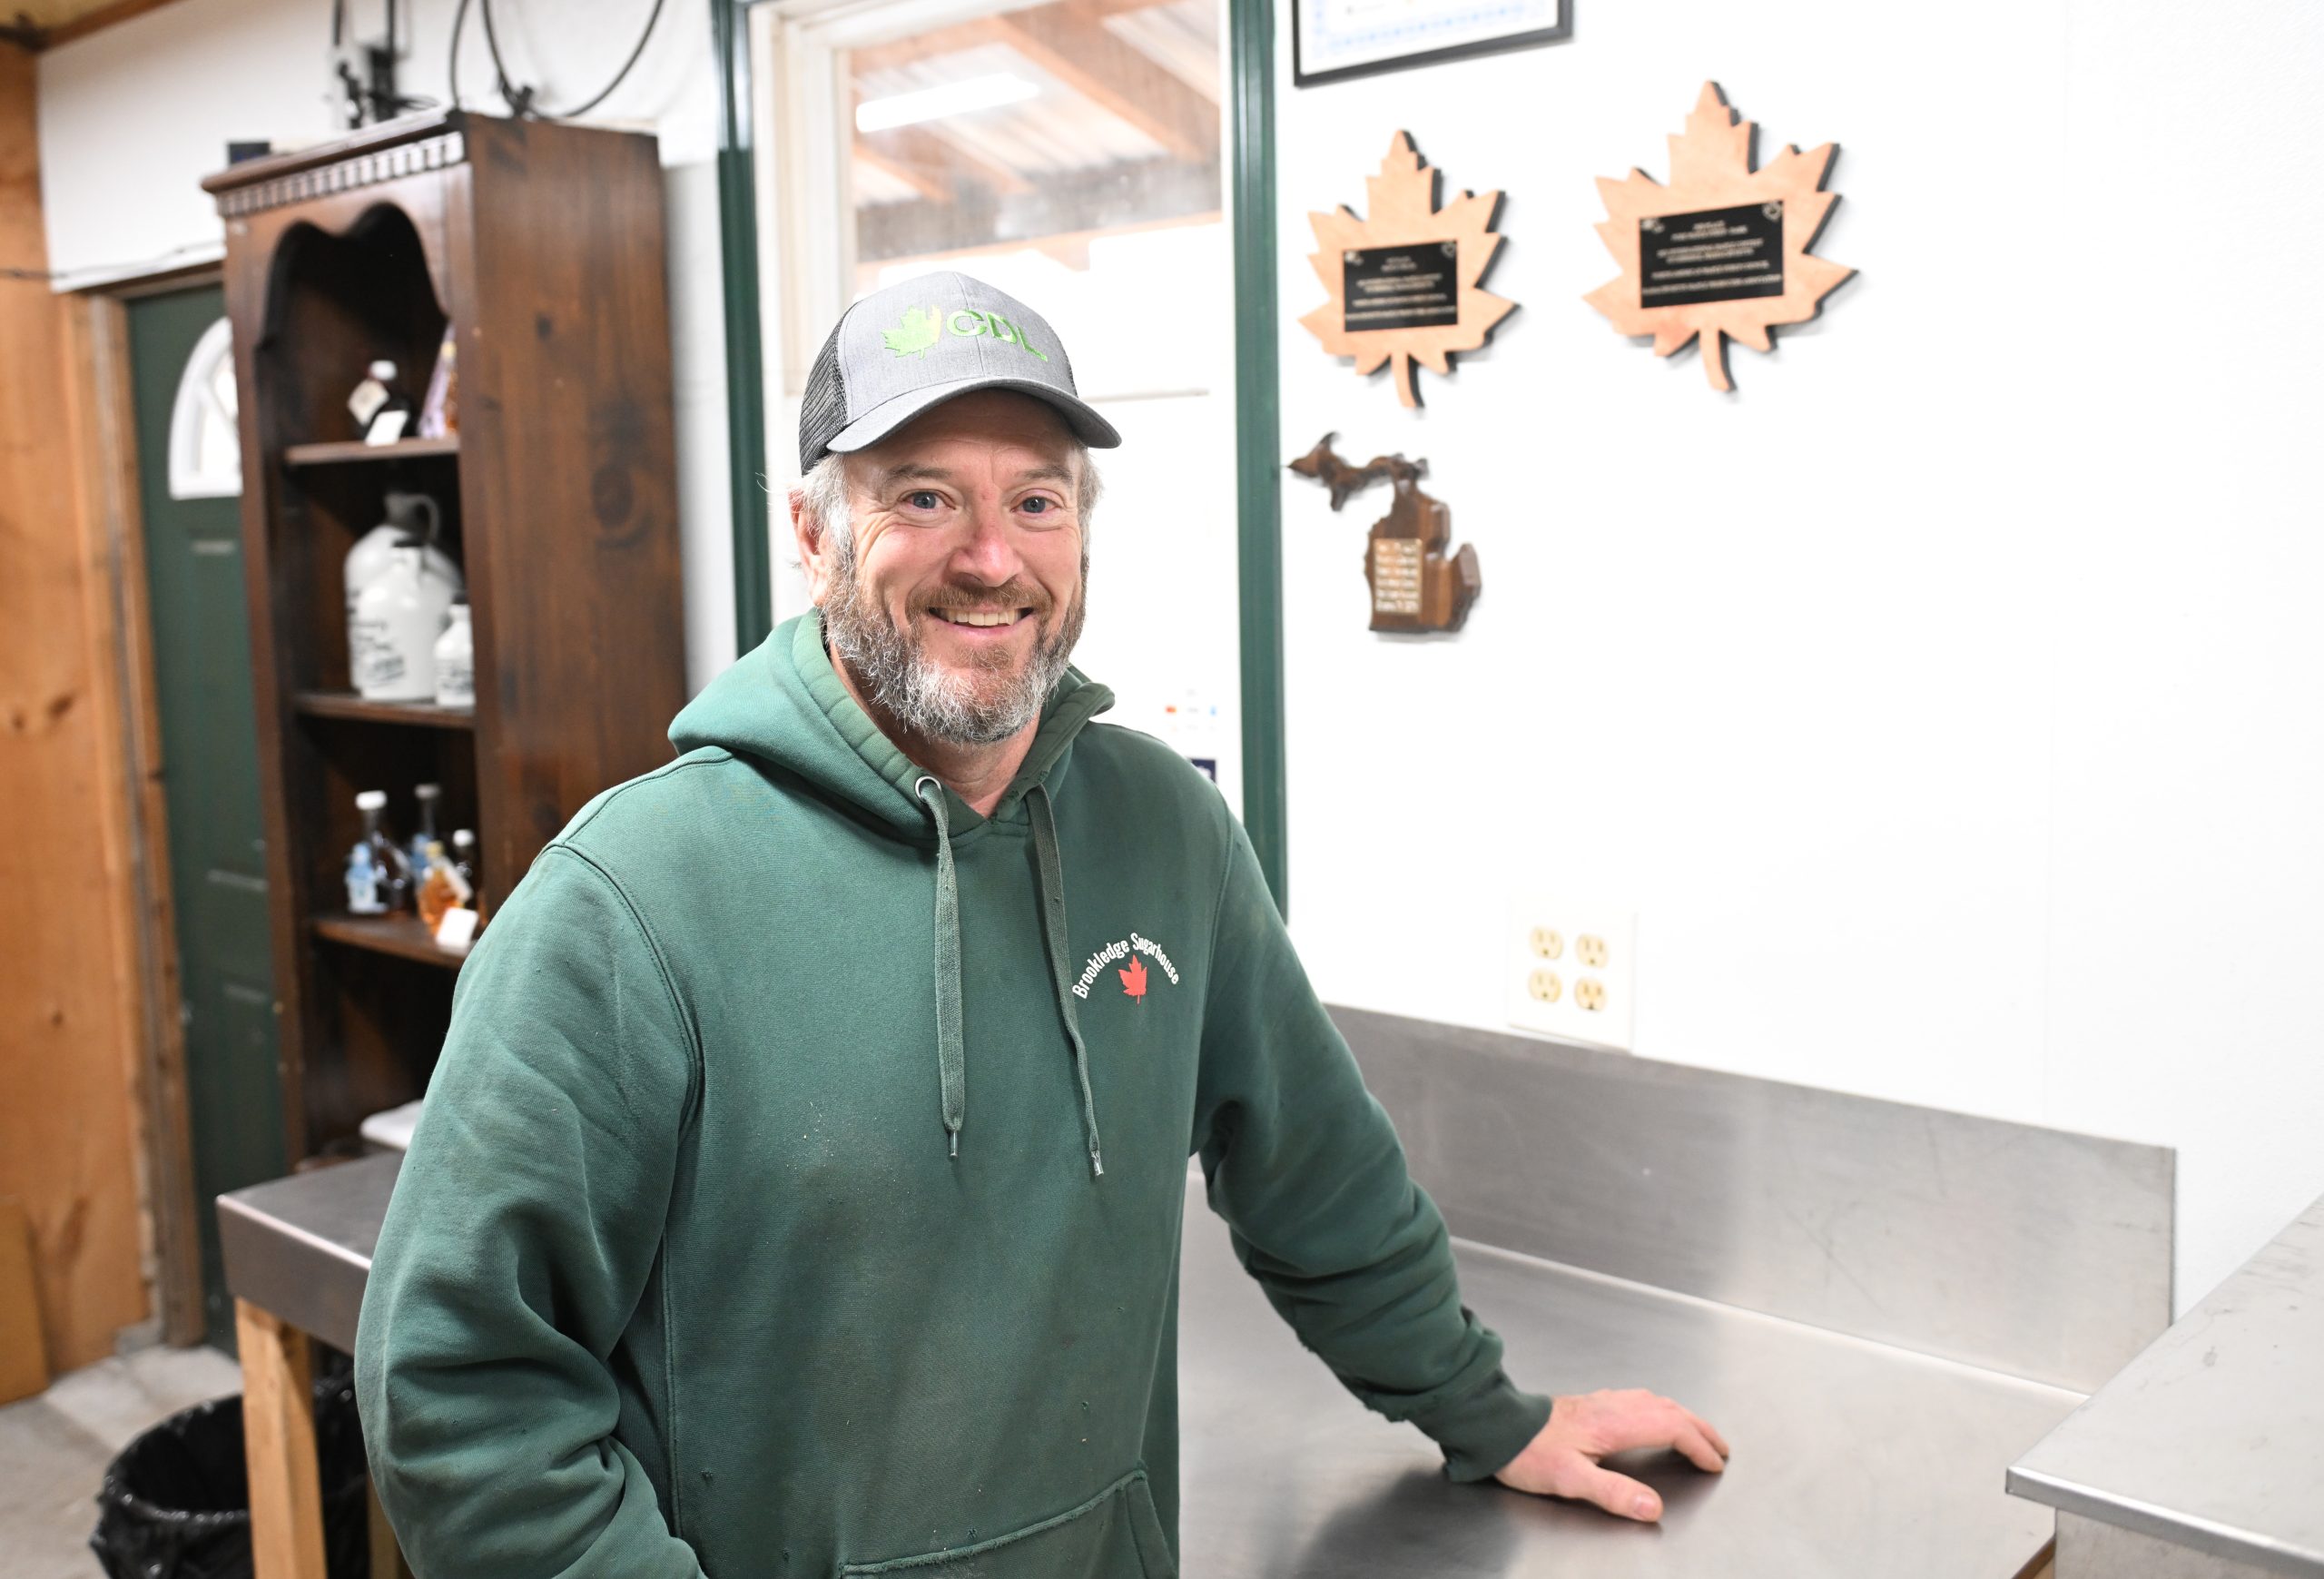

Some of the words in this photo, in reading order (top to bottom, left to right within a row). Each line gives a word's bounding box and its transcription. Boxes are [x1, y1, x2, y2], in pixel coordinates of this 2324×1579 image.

[946, 309, 1049, 362] CDL
[1072, 940, 1130, 999] Brookledge
[1130, 932, 1179, 985] Sugarhouse
